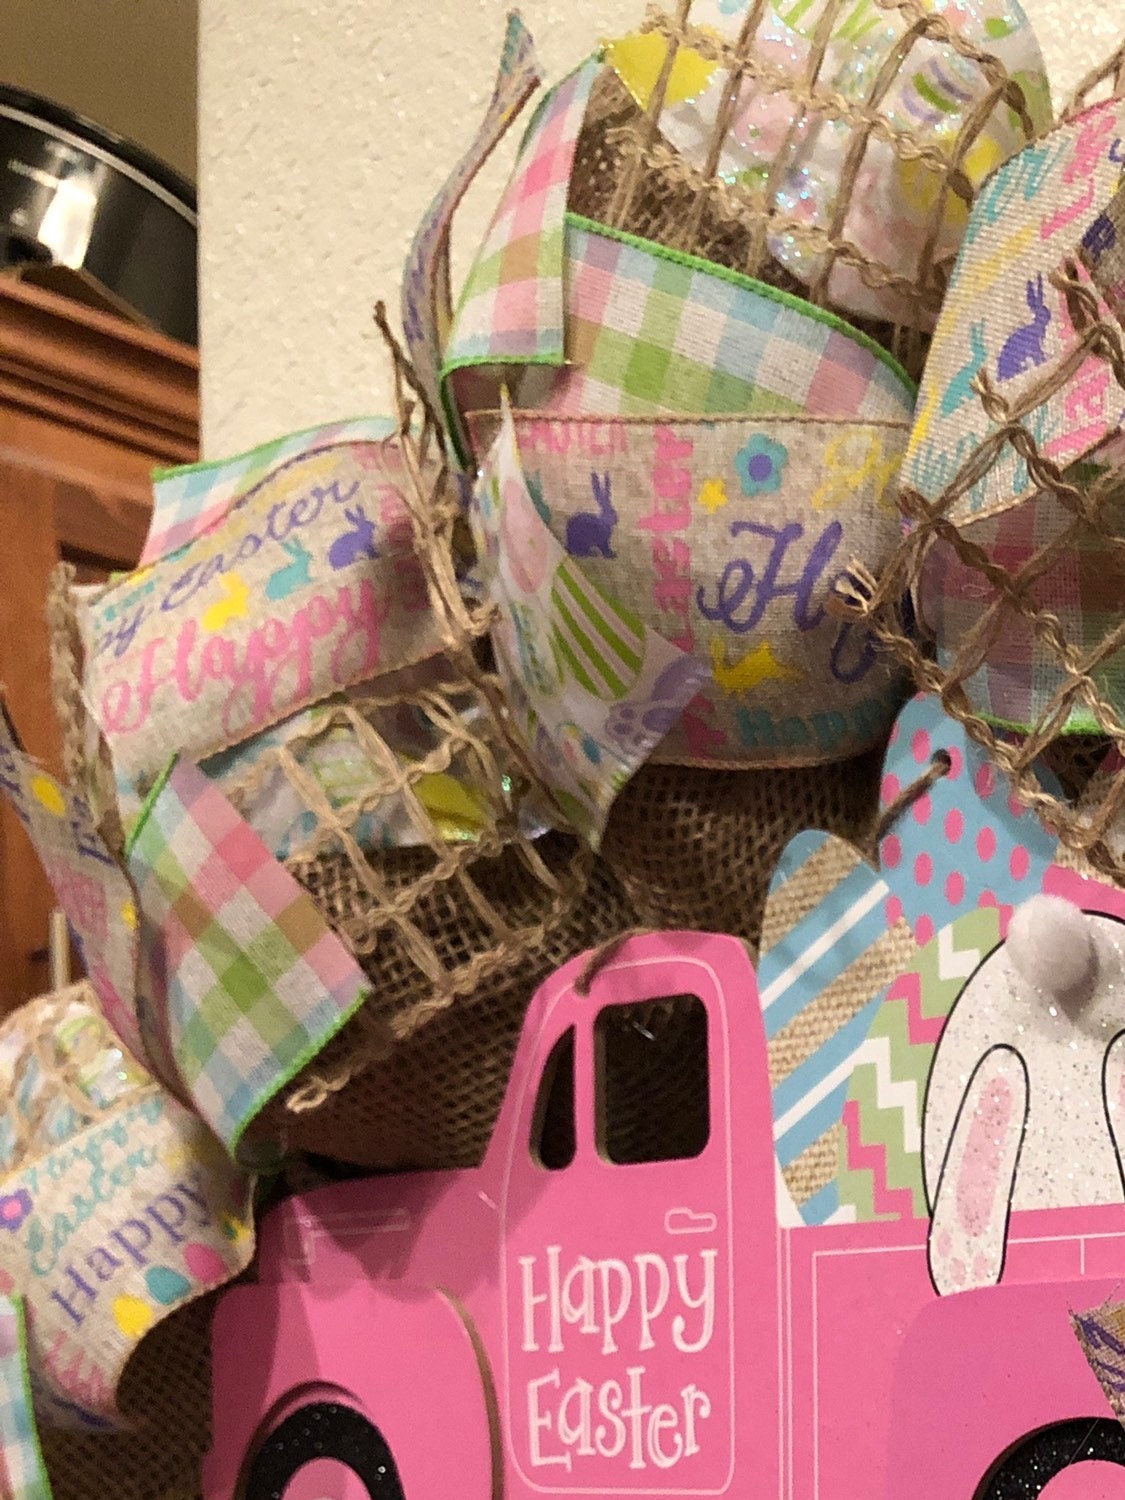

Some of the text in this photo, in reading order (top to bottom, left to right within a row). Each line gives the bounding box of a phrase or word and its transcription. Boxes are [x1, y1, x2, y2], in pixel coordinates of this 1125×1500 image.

[101, 578, 384, 741] Happy
[50, 1175, 214, 1330] Happy
[517, 1244, 719, 1355] Happy
[527, 1366, 712, 1473] Easter
